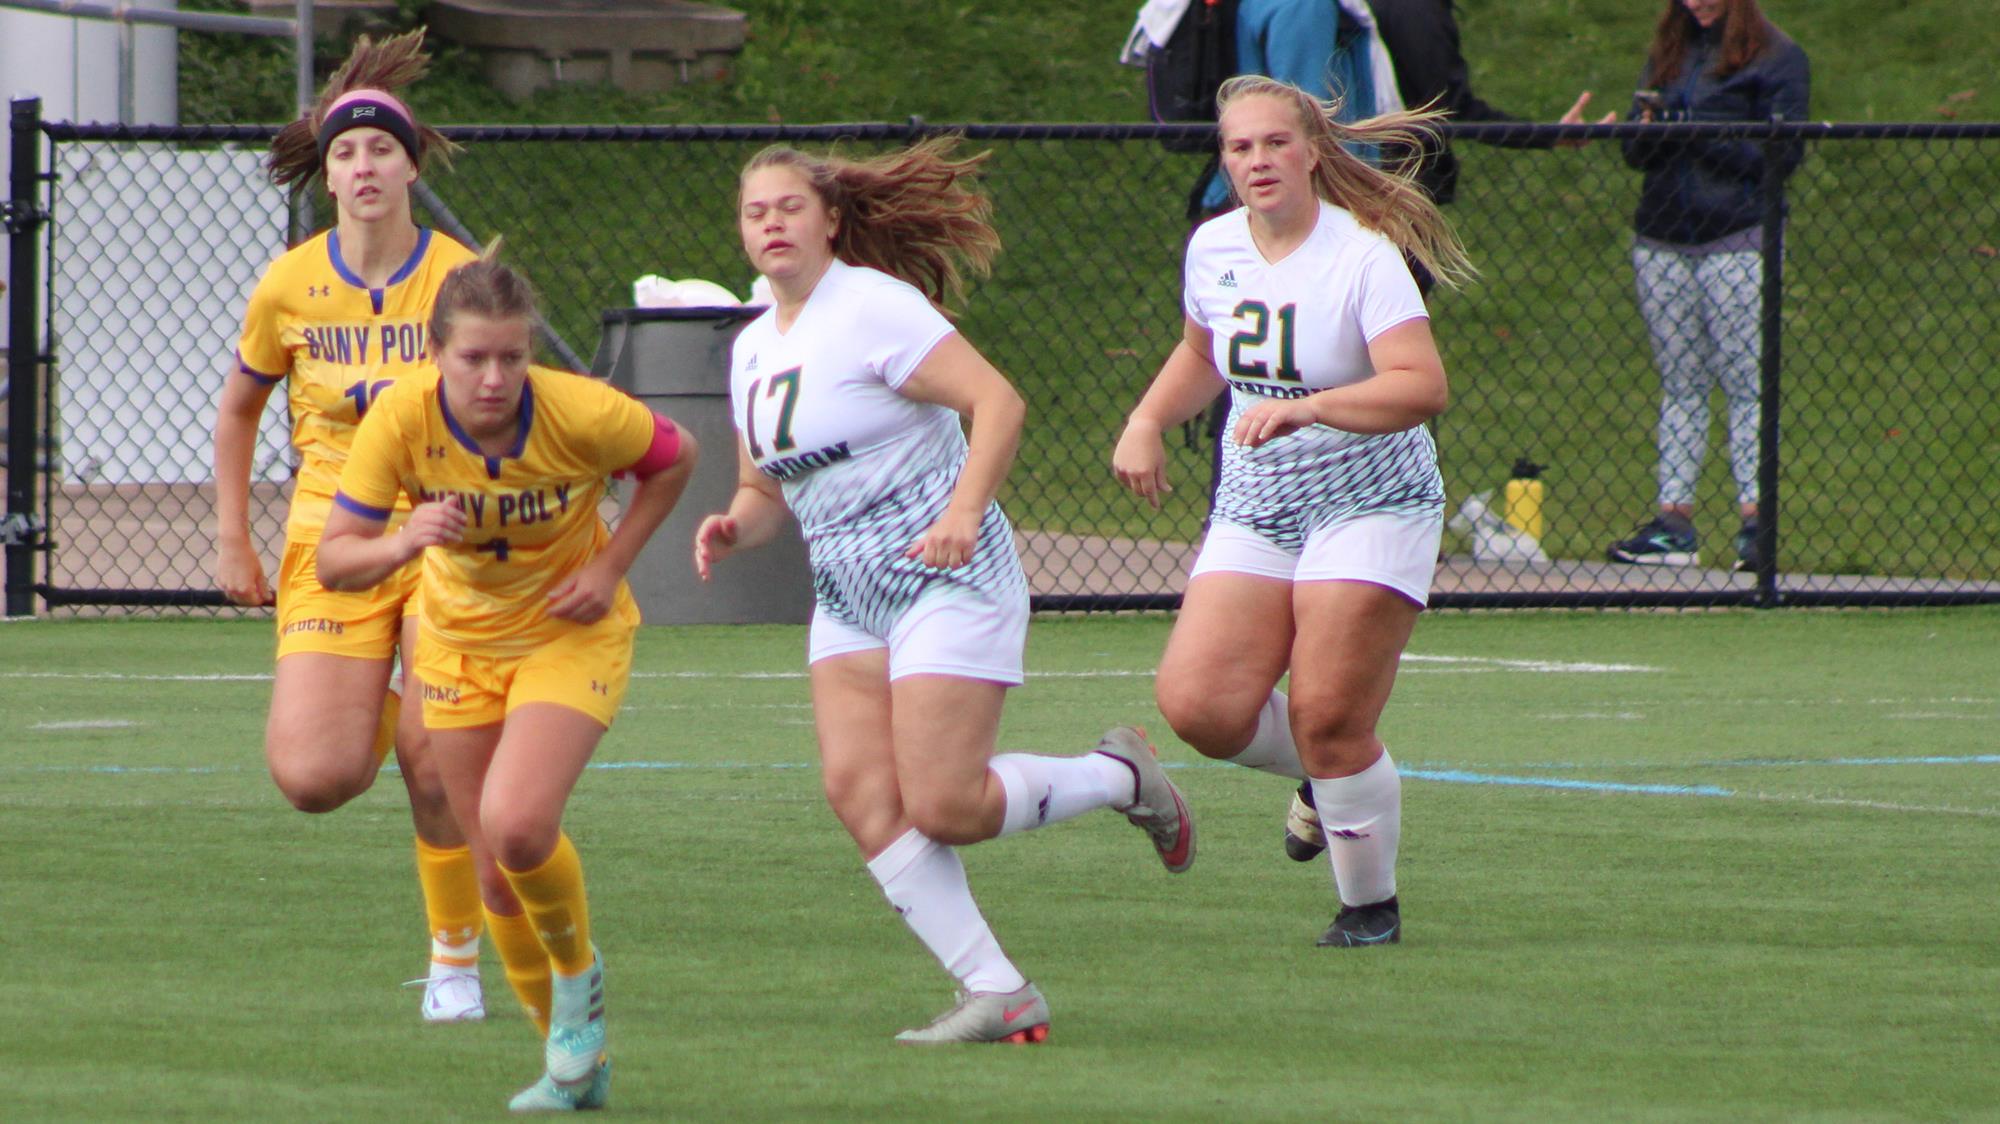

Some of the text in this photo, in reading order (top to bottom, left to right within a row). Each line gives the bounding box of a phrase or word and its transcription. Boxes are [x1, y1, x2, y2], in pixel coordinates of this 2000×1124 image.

[303, 322, 428, 366] SUNY POL
[1228, 299, 1303, 382] 21
[747, 364, 802, 460] 17
[498, 482, 571, 527] POLY
[476, 536, 510, 562] 4
